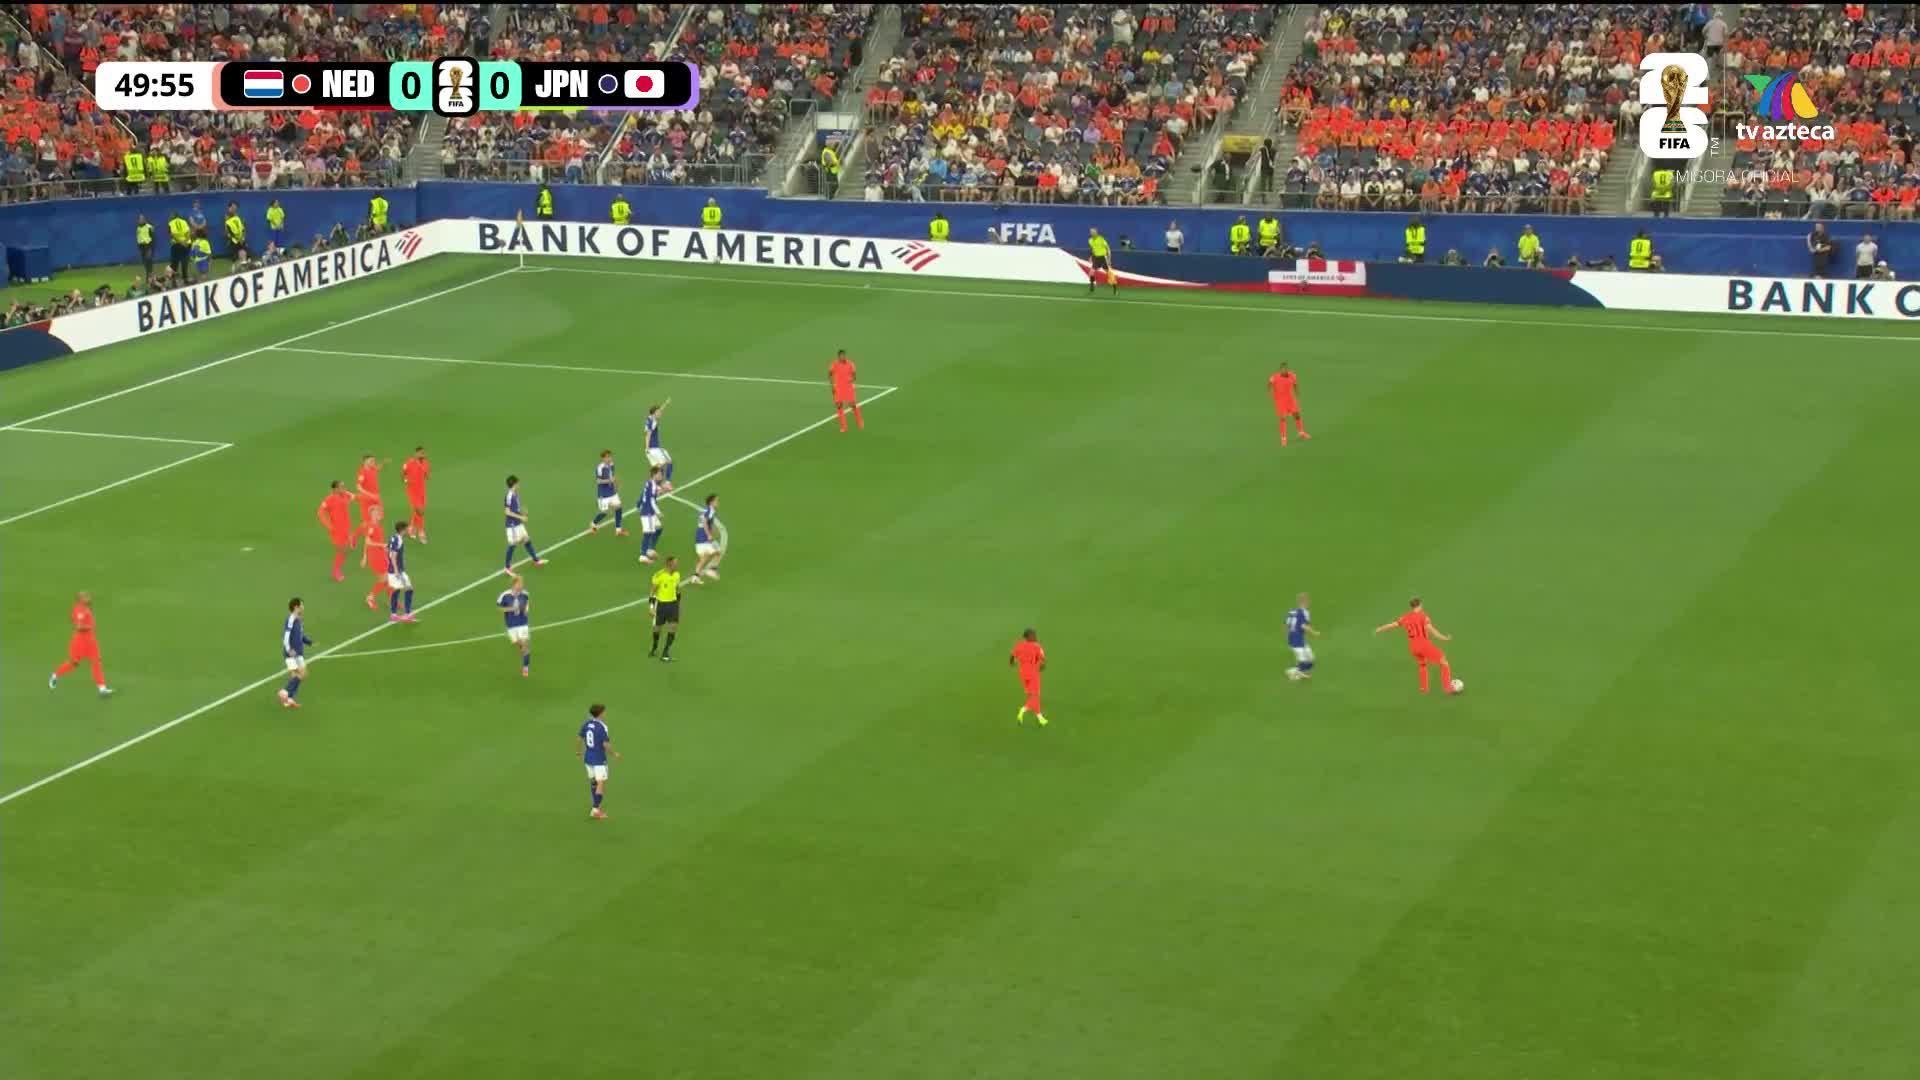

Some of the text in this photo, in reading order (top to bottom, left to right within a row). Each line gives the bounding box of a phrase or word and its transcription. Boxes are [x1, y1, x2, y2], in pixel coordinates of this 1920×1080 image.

[478, 222, 883, 270] BANK OF AMERICA
[1000, 222, 1057, 244] FIFA
[137, 238, 392, 333] BANK OF AMERICA
[1727, 278, 1876, 316] BANK
